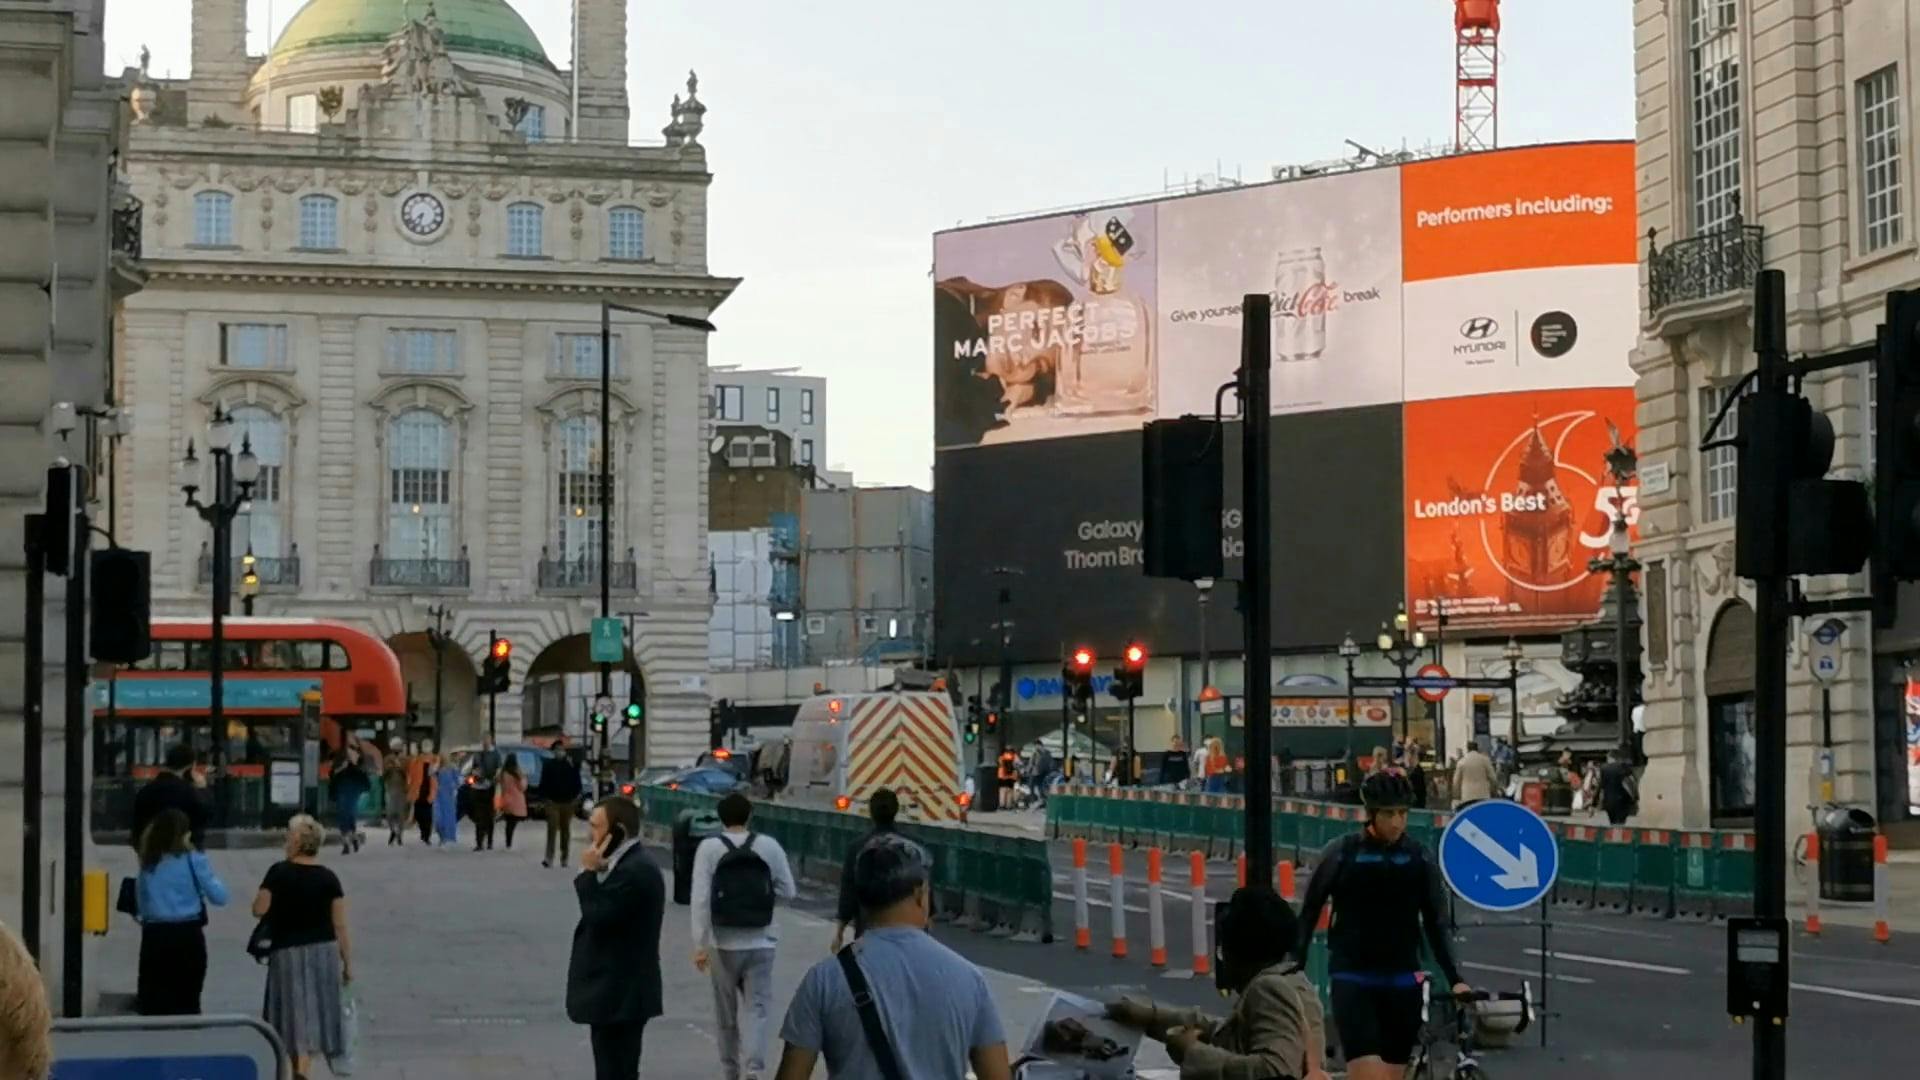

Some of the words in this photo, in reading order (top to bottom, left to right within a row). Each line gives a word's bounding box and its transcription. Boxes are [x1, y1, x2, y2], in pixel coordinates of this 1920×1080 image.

[1416, 203, 1513, 228] Performers
[1170, 308, 1198, 322] Give
[1343, 287, 1380, 302] break
[987, 303, 1101, 333] PERFECT
[953, 335, 1023, 360] MARC
[1030, 321, 1137, 349] JACOBS
[1453, 341, 1506, 354] HYUNDAI
[1414, 494, 1497, 518] London's
[1500, 492, 1547, 512] Best
[1078, 519, 1144, 542] Galaxy
[1063, 549, 1117, 569] Thom
